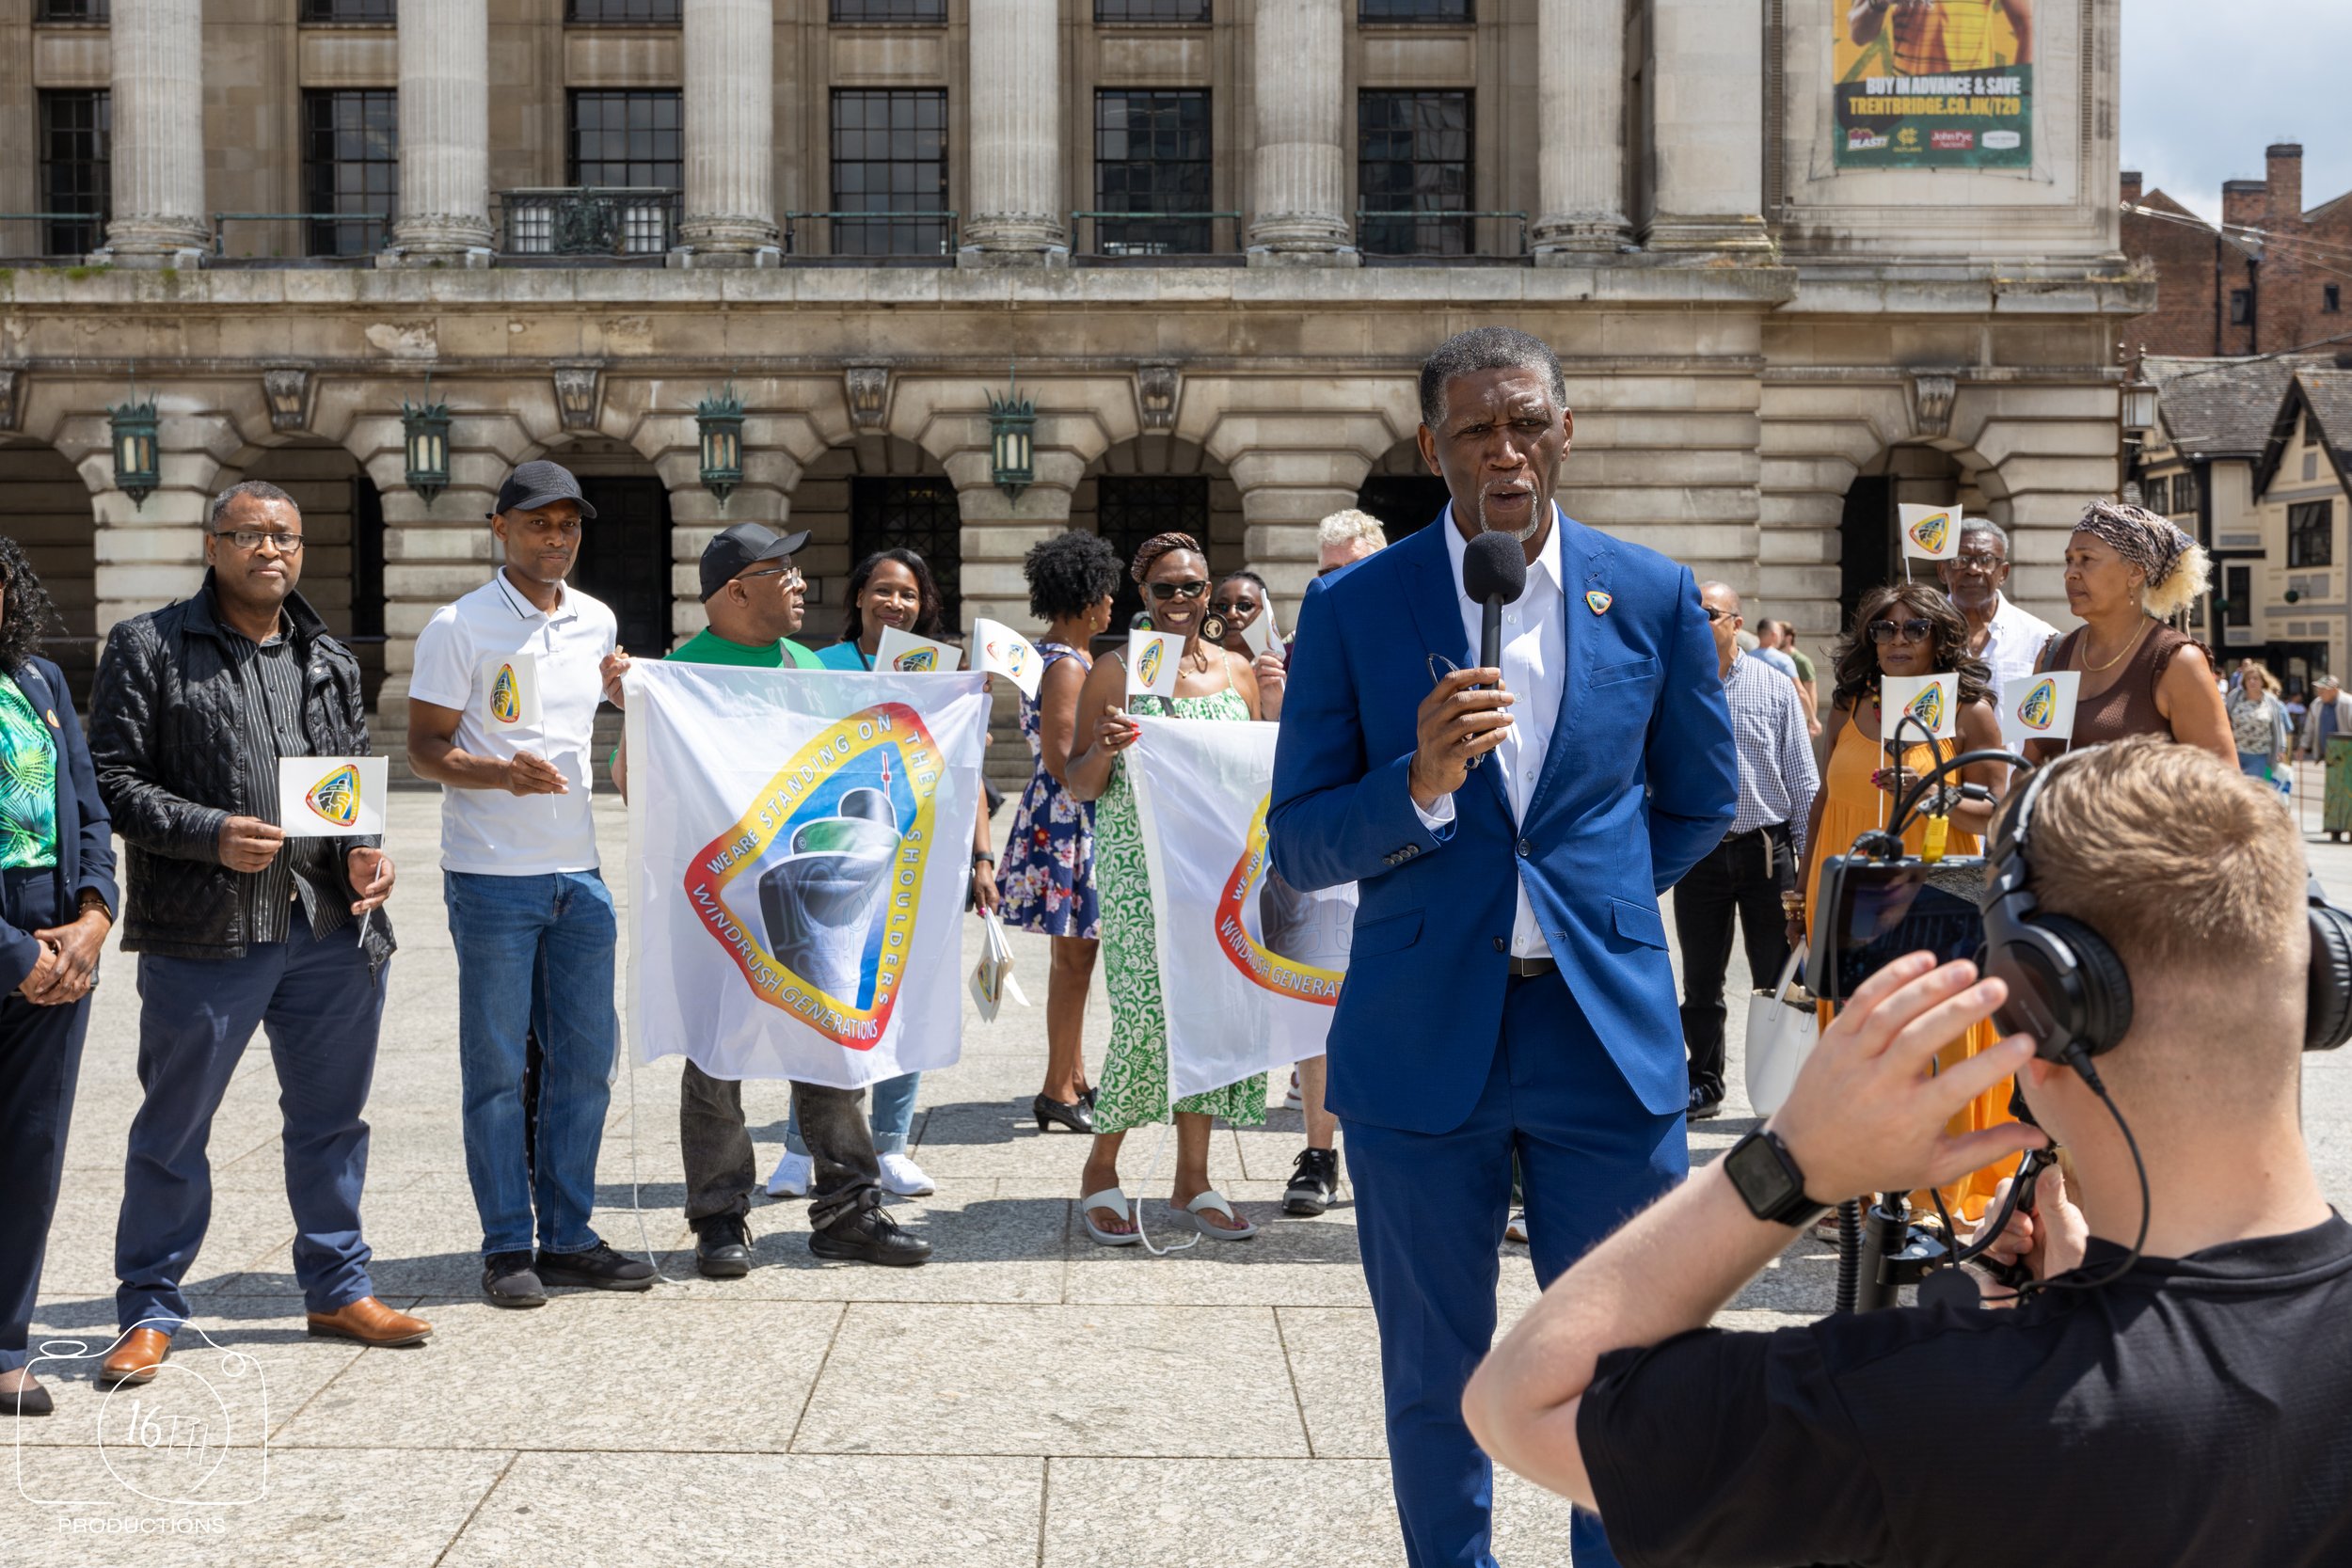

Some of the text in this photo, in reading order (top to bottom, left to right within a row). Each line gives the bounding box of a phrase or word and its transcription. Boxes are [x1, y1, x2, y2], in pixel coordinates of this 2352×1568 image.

[1849, 97, 2021, 117] TRENTBRIDGE.CO.UK/T20
[1866, 76, 2021, 94] BUY IN ADVANCE & SAVE
[707, 851, 733, 876] WE
[732, 829, 760, 861] ARE
[758, 736, 850, 829] STANDING
[858, 714, 892, 740] ON
[878, 828, 922, 1006] SHOULDERS
[1232, 875, 1248, 901] WE
[692, 883, 785, 992] WINDRUSH
[782, 987, 879, 1040] GENERATIONS
[1220, 914, 1272, 978] WINDRUSH
